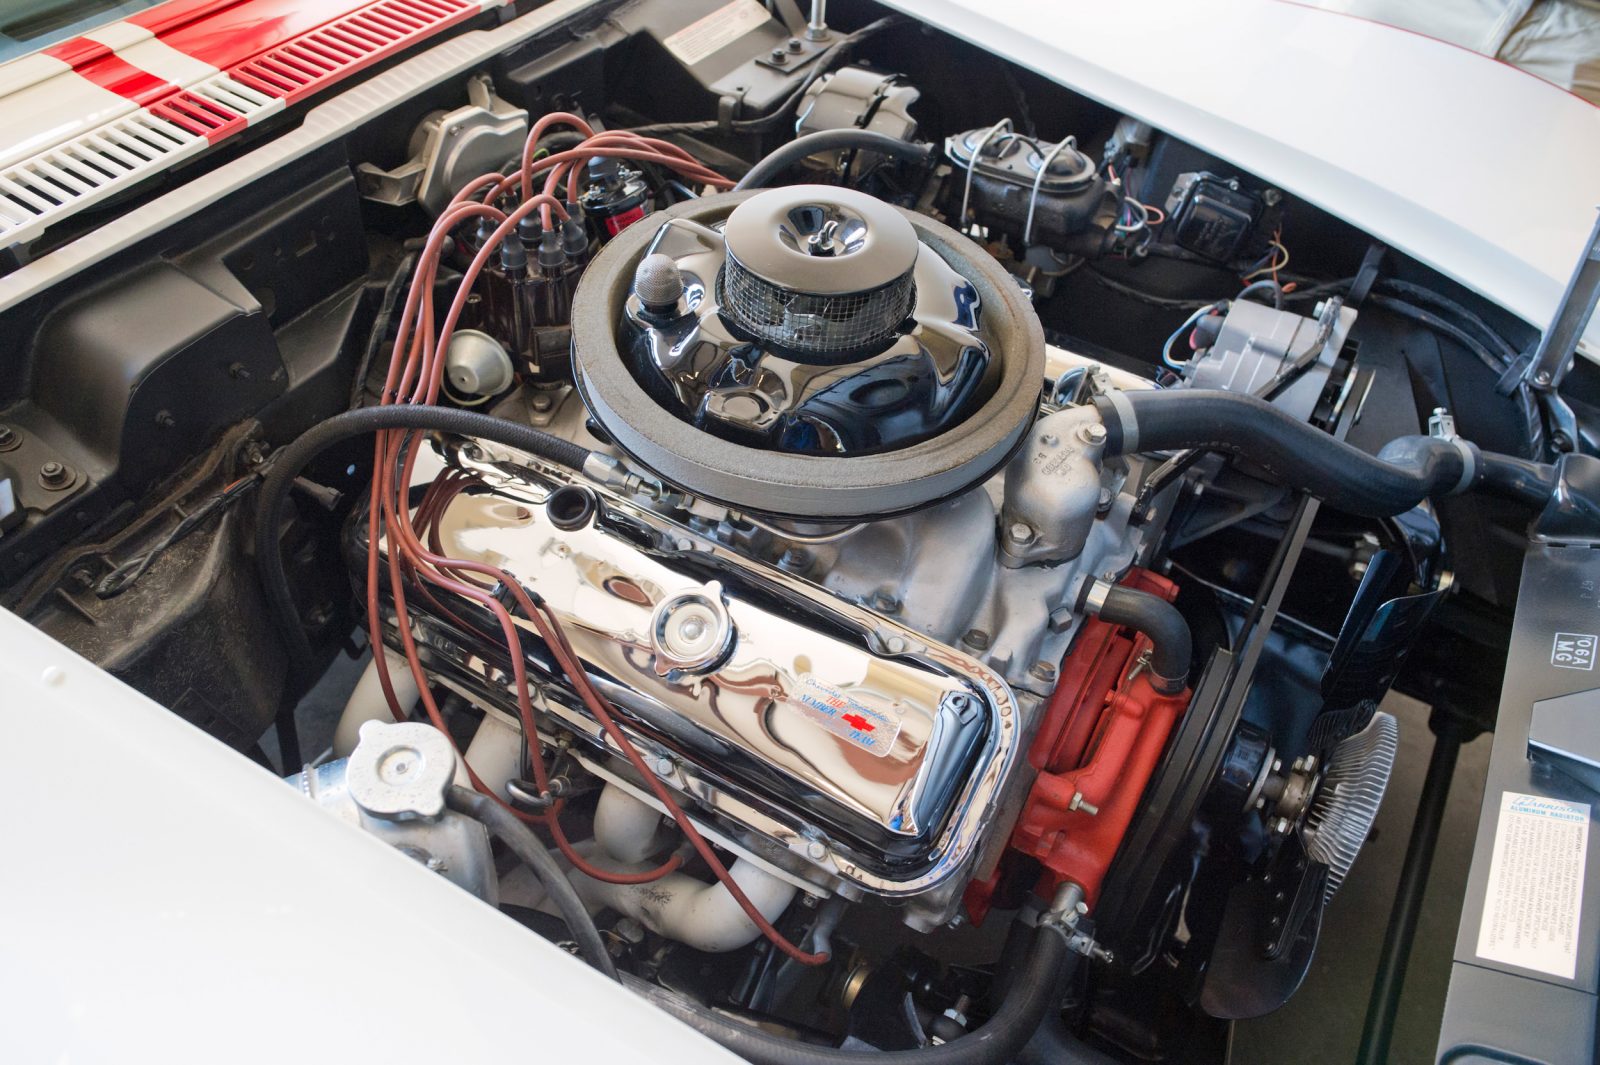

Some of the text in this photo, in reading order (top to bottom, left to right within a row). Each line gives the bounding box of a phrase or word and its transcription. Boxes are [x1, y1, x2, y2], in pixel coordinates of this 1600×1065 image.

[1555, 640, 1575, 662] MG
[801, 694, 838, 717] NUMBER
[825, 695, 847, 709] THE
[1510, 804, 1585, 823] ALUMINUM RADIATOR
